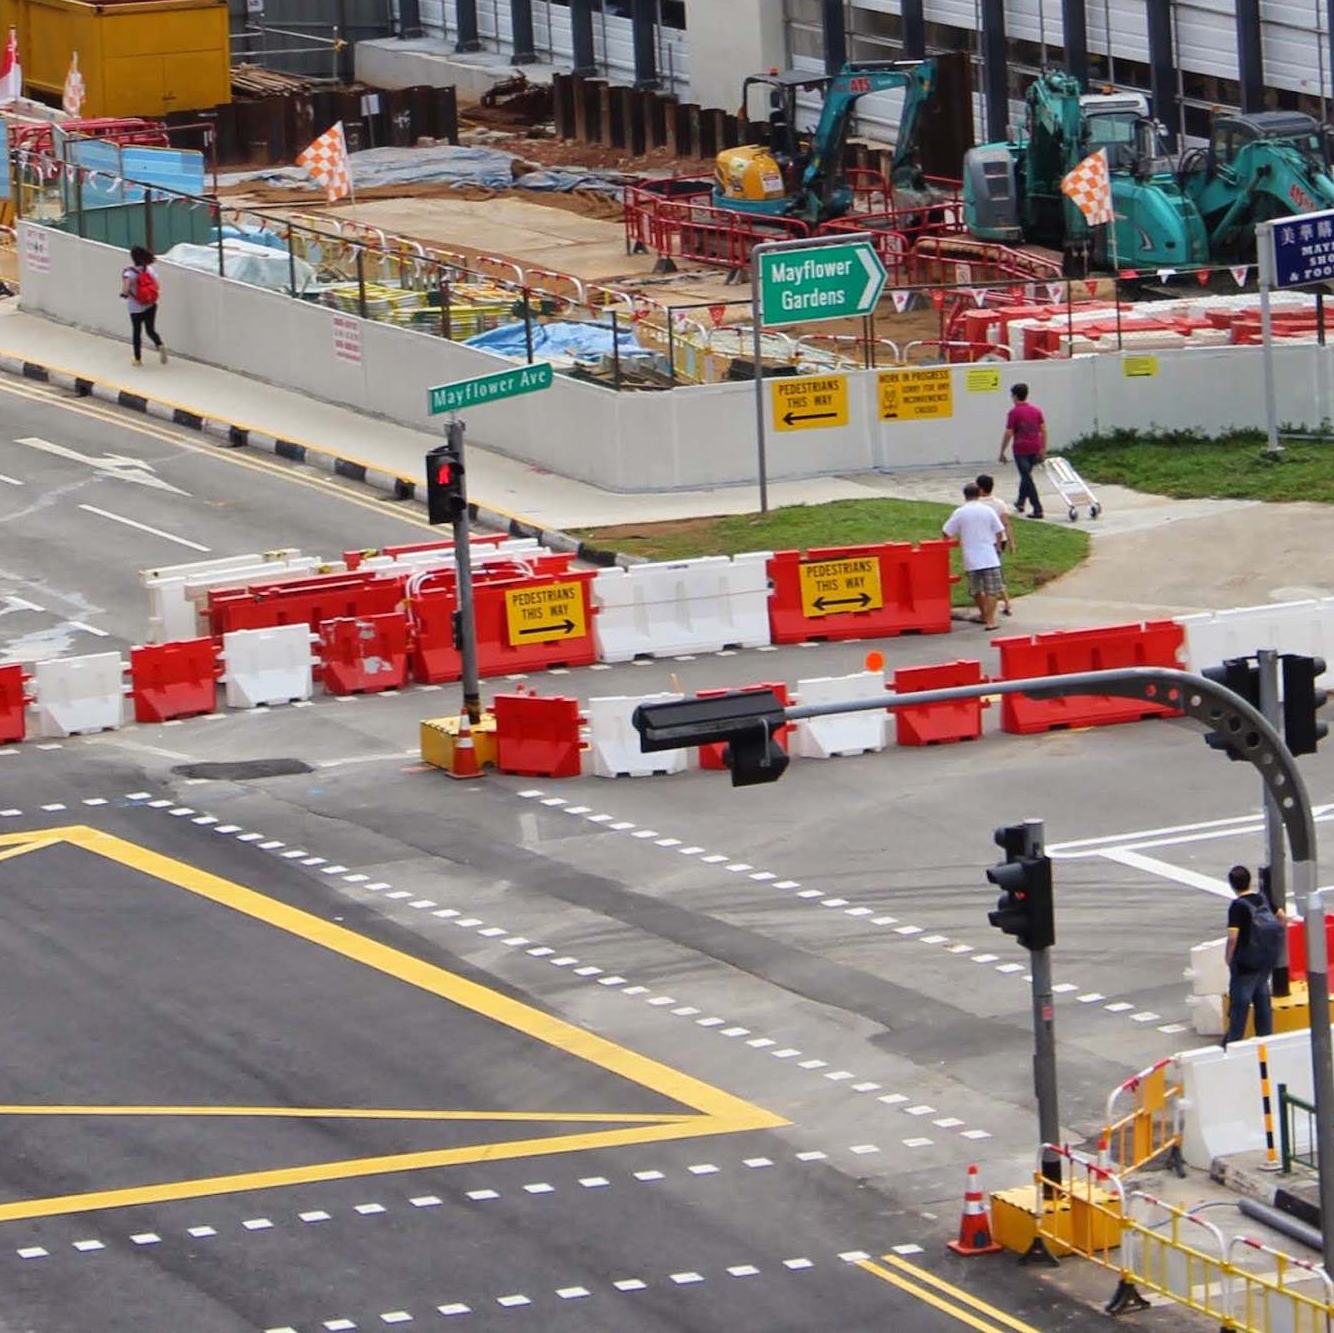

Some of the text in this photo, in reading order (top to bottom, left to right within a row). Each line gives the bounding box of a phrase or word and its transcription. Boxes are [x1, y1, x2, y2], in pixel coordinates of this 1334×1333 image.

[771, 260, 852, 286] Mayflower
[1289, 271, 1299, 282] &
[782, 288, 845, 310] Gardens
[879, 370, 949, 383] WORK IN PROGRESS
[434, 370, 546, 406] Mayflower Ave
[779, 380, 839, 396] PEDESTRIANS
[787, 395, 832, 408] THIS WAY
[807, 560, 873, 578] PEDESTRIANS
[816, 577, 865, 591] THIS WAY
[512, 587, 575, 606] PEDESTRIANS
[522, 604, 568, 620] THIS WAY
